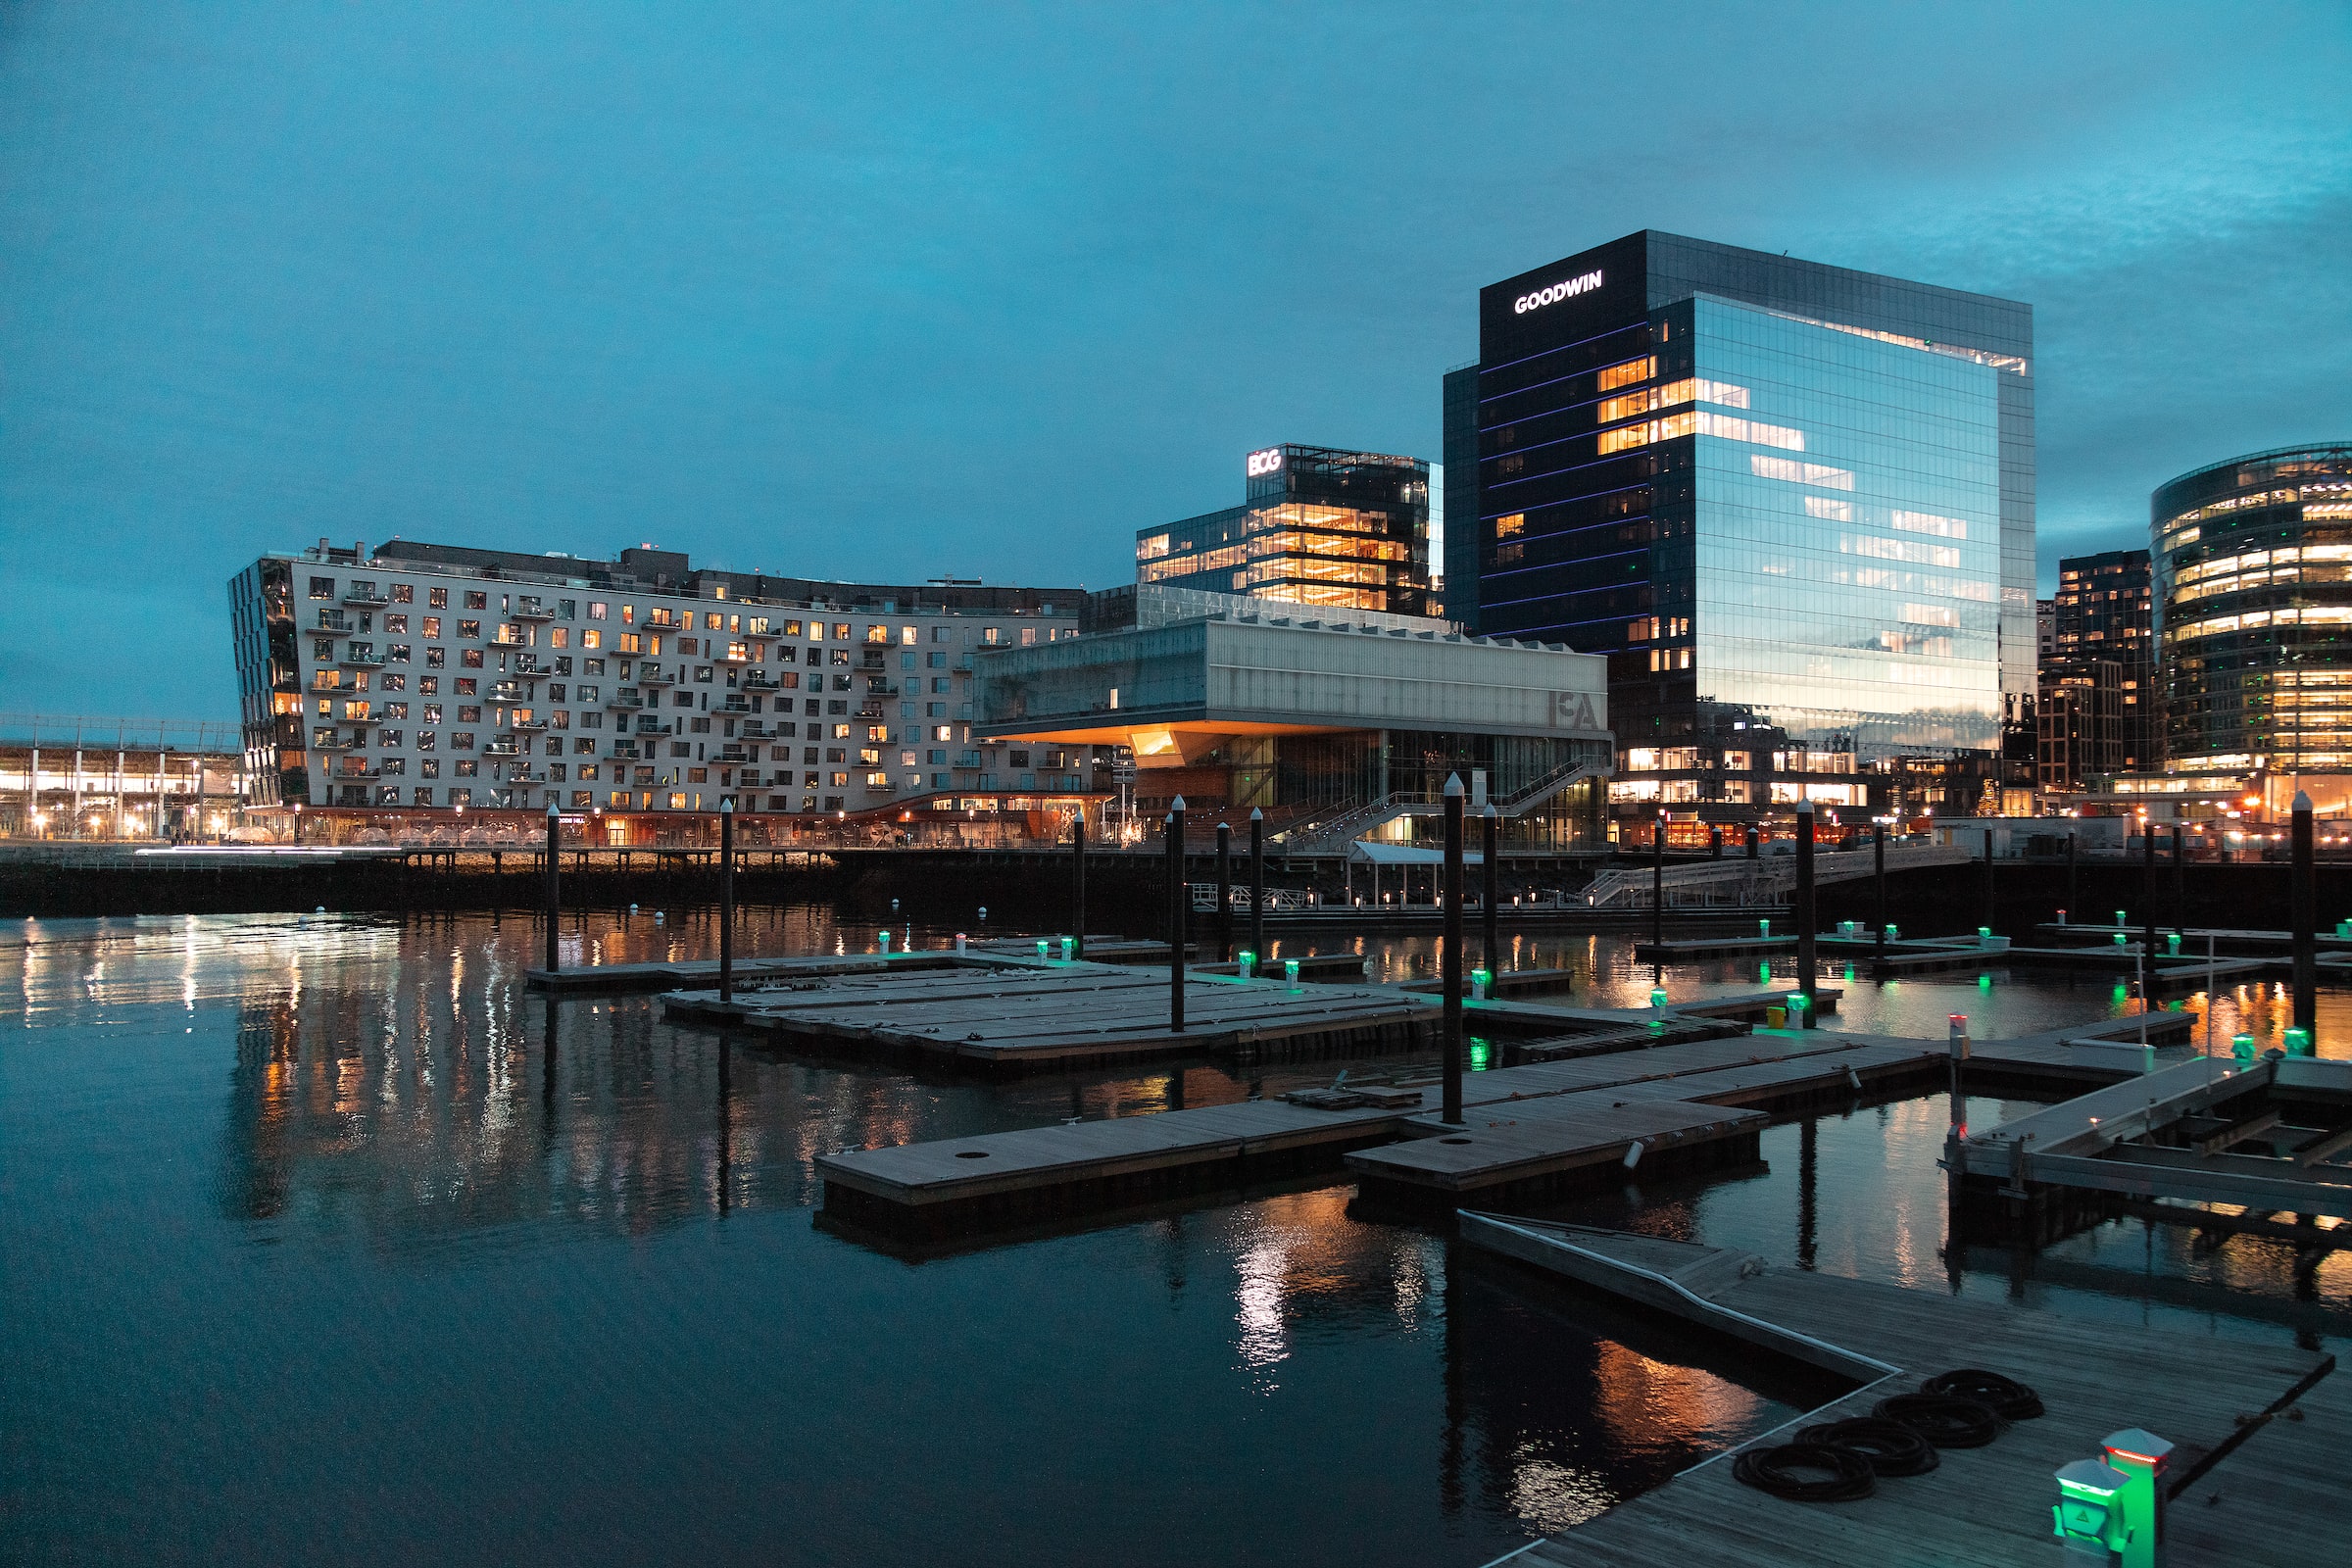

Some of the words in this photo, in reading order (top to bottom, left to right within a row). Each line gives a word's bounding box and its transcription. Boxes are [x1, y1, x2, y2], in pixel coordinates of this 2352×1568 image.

[1514, 270, 1602, 314] GOODWIN
[1249, 449, 1282, 476] BCG
[1548, 690, 1599, 730] ICA
